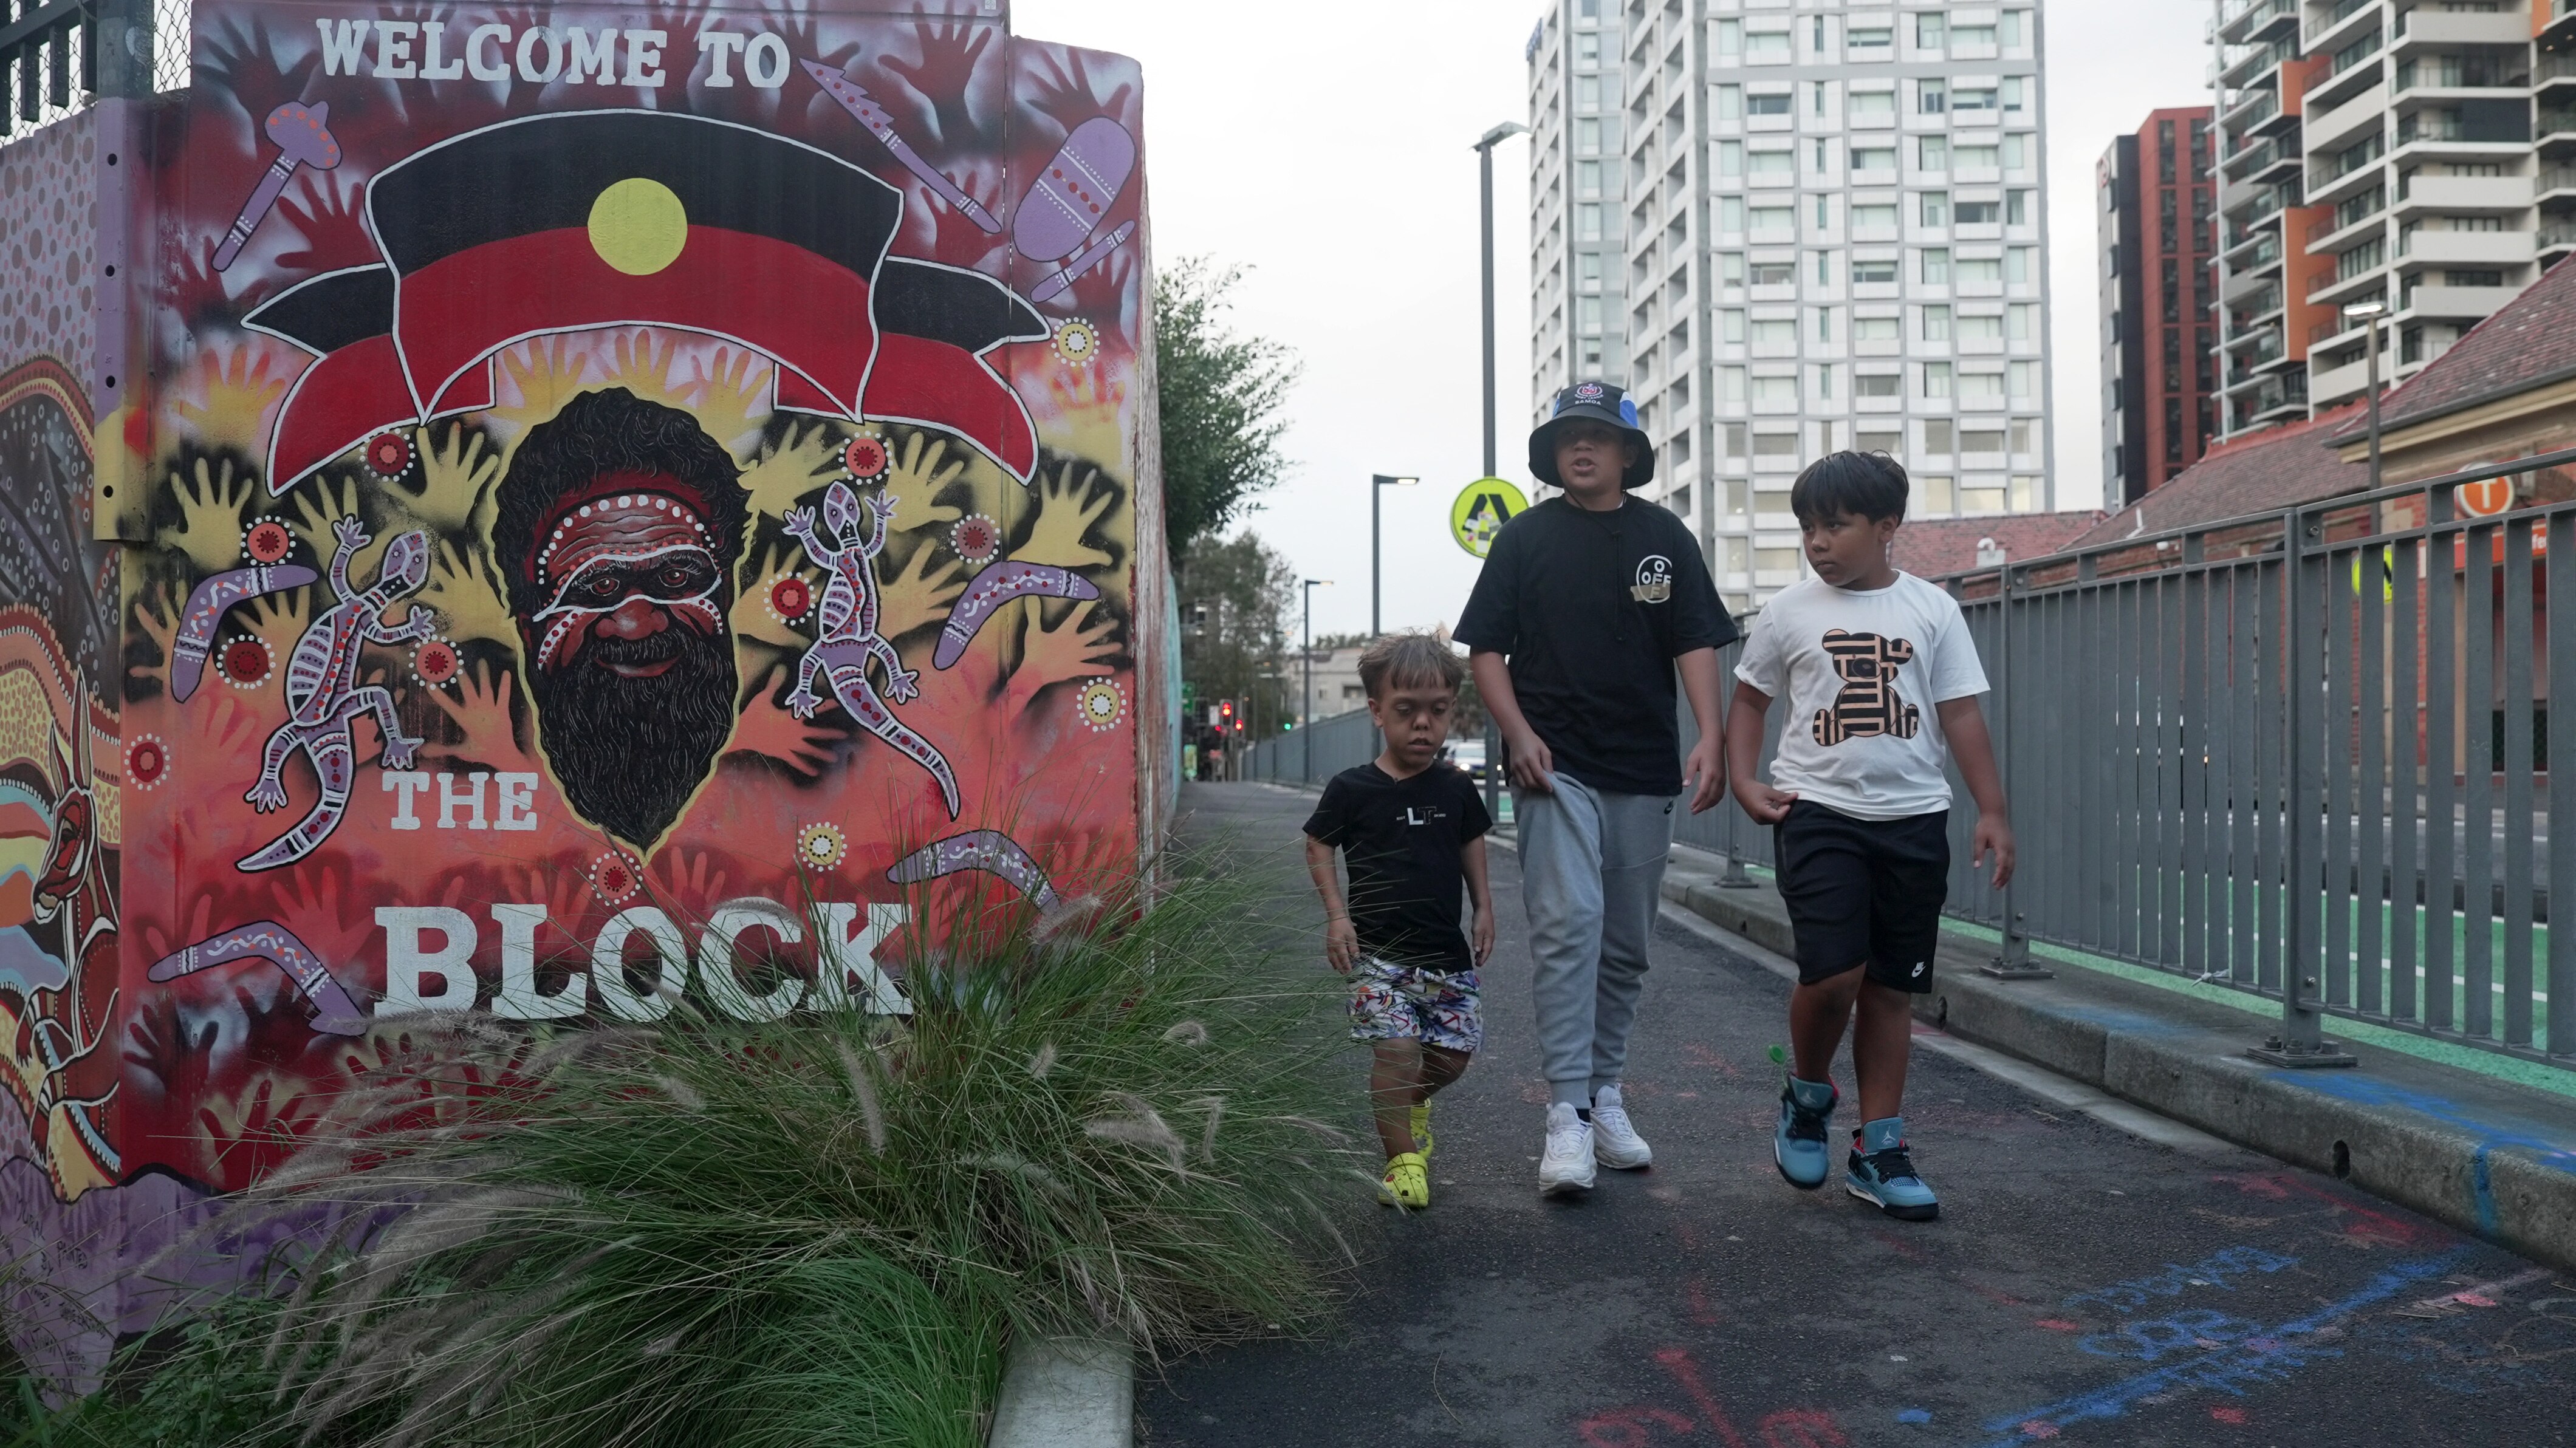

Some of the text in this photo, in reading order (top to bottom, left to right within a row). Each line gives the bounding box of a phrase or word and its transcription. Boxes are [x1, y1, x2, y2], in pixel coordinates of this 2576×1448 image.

[316, 19, 791, 88] WELCOME TO
[2473, 477, 2498, 509] T
[382, 771, 538, 830] THE
[374, 902, 913, 1023] BLOCK
